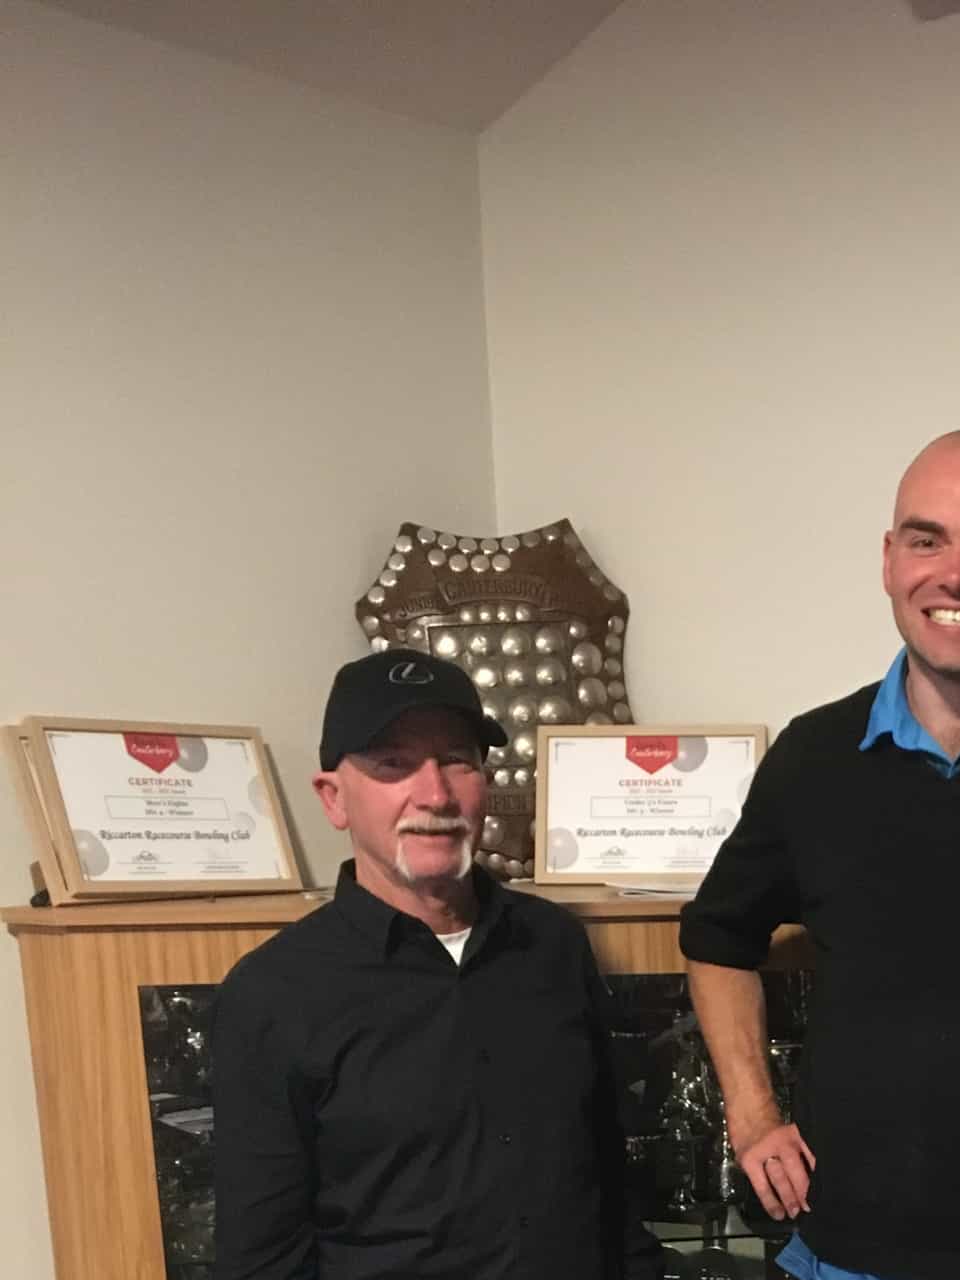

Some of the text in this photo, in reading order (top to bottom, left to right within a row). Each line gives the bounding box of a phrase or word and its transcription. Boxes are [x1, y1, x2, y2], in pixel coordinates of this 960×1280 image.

[128, 777, 193, 788] CERTIFICATE
[618, 779, 683, 788] CERTIFICATE
[99, 829, 250, 843] Riccarton Racecourse Bowling Club
[577, 827, 617, 838] Riccarton
[668, 826, 704, 838] Bowling
[706, 826, 727, 837] Club
